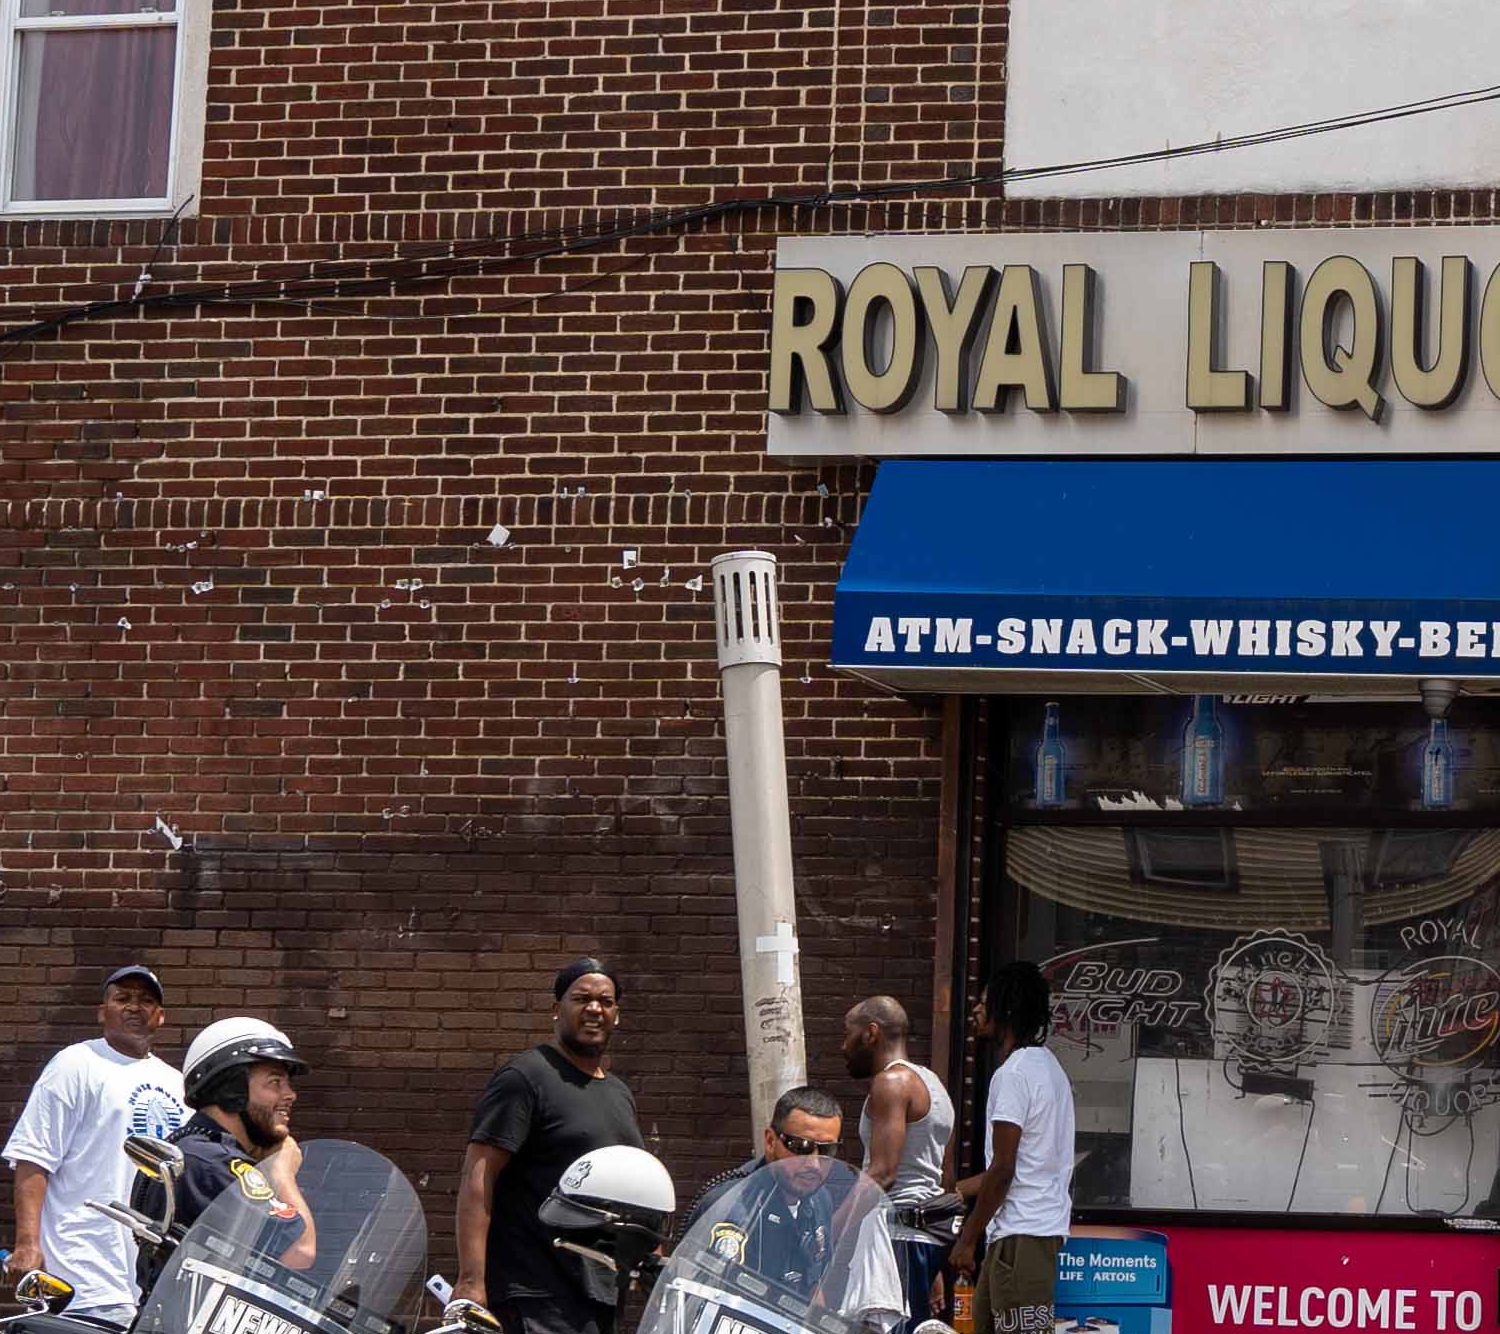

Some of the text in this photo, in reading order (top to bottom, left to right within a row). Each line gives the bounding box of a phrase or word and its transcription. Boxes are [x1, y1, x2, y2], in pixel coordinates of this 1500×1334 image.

[768, 262, 1129, 415] ROYAL
[1400, 917, 1481, 951] ROYAL
[1063, 961, 1183, 996] BUD
[1051, 998, 1202, 1028] LIGHT
[1058, 1252, 1157, 1268] The Moments
[1059, 1271, 1137, 1283] LIFE ARTOIS
[1207, 1284, 1482, 1332] WELCOME TO
